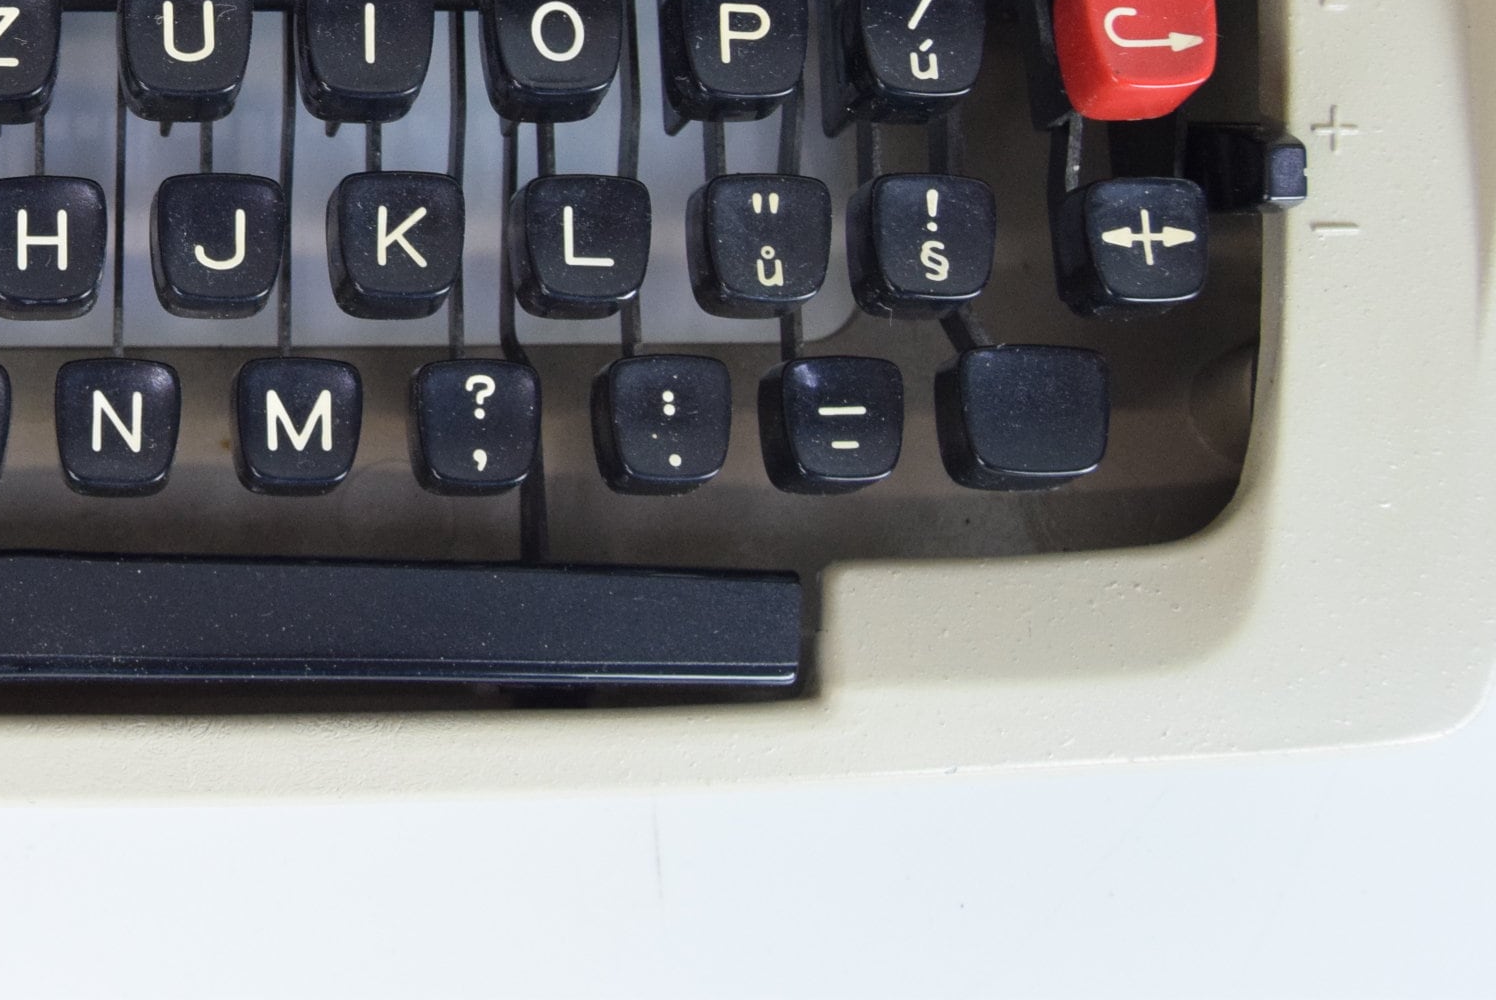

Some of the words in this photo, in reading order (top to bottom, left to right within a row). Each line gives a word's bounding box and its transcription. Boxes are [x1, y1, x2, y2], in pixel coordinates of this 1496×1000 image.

[161, 0, 215, 64] U
[530, 2, 583, 60] O
[718, 2, 772, 64] P
[909, 38, 939, 81] ú
[16, 209, 69, 270] H
[193, 209, 247, 271] J
[375, 206, 427, 267] K
[562, 208, 614, 267] L
[925, 189, 940, 232] !
[756, 245, 785, 287] ů
[94, 391, 144, 451] N
[266, 388, 333, 450] M
[465, 374, 496, 420] ?
